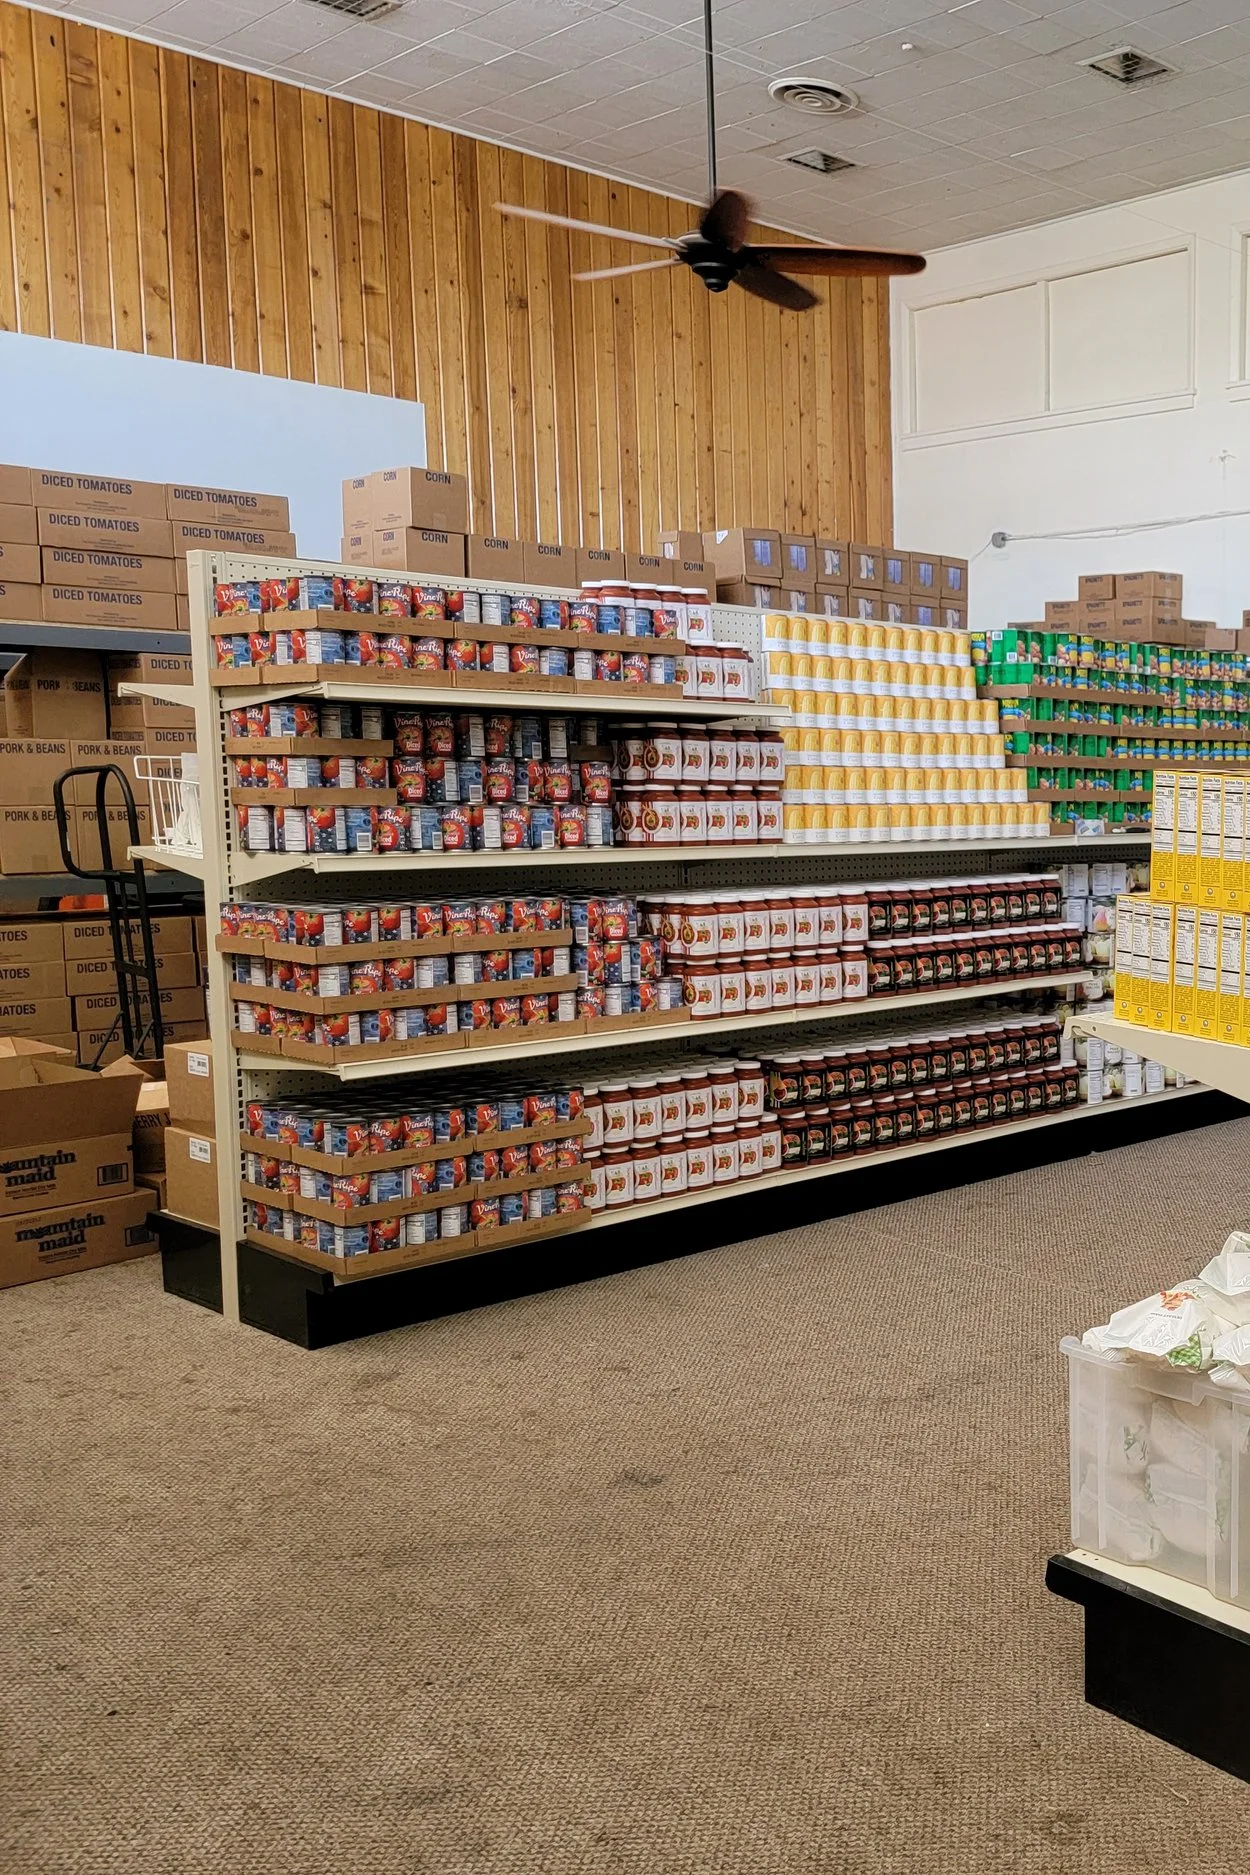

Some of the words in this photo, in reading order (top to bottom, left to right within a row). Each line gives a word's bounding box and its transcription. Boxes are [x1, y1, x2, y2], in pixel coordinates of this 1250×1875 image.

[42, 474, 74, 488] DICED
[77, 478, 132, 494] TOMATOES
[426, 472, 450, 484] CORN
[174, 488, 203, 501] DICED
[205, 492, 258, 507] TOMATOES
[49, 513, 80, 527] DICED
[84, 517, 140, 532] TOMATOES
[182, 526, 212, 539] DICED
[214, 530, 265, 544] TOMATOES
[422, 532, 448, 544] CORN
[484, 538, 508, 550] CORN
[538, 545, 562, 556] CORN
[588, 550, 610, 562] CORN
[54, 550, 84, 564] DICED
[87, 554, 143, 568] TOMATOES
[639, 556, 660, 568] CORN
[684, 562, 704, 572] CORN
[52, 588, 84, 601] DICED
[87, 592, 142, 605] TOMATOES
[151, 659, 180, 670] DICED
[155, 732, 184, 742] DICED
[36, 744, 66, 754] BEANS
[78, 745, 102, 755] PORK
[112, 746, 142, 756] BEANS
[5, 811, 30, 821] PORK
[74, 926, 105, 938] DICED
[76, 963, 108, 974] DICED
[86, 997, 117, 1009] DICED
[38, 1229, 87, 1252] maid
